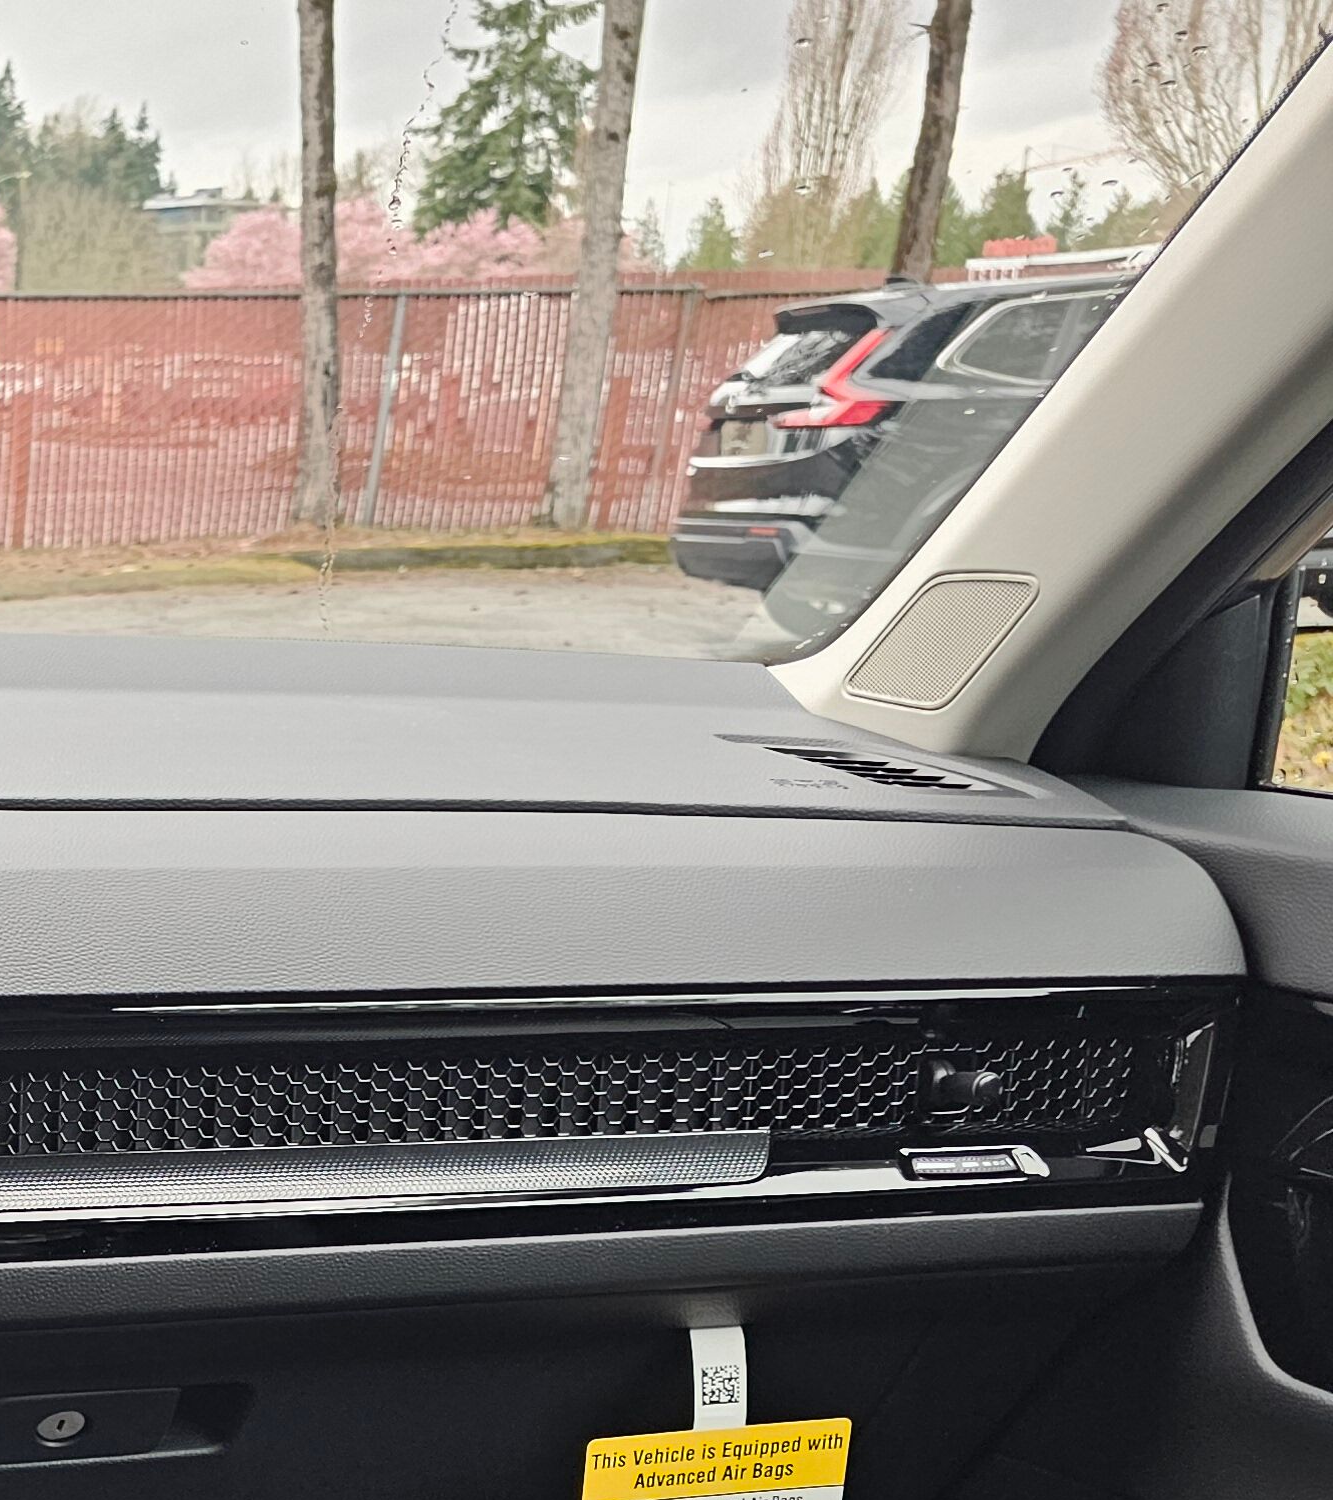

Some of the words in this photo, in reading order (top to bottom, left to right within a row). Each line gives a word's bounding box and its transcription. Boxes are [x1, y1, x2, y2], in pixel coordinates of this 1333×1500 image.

[592, 1452, 627, 1470] This
[633, 1446, 695, 1466] Vehicle
[702, 1444, 716, 1460] is
[722, 1436, 801, 1460] Equipped
[808, 1434, 844, 1451] with
[634, 1467, 717, 1489] Advanced
[722, 1465, 747, 1481] Air
[753, 1463, 794, 1480] Bags
